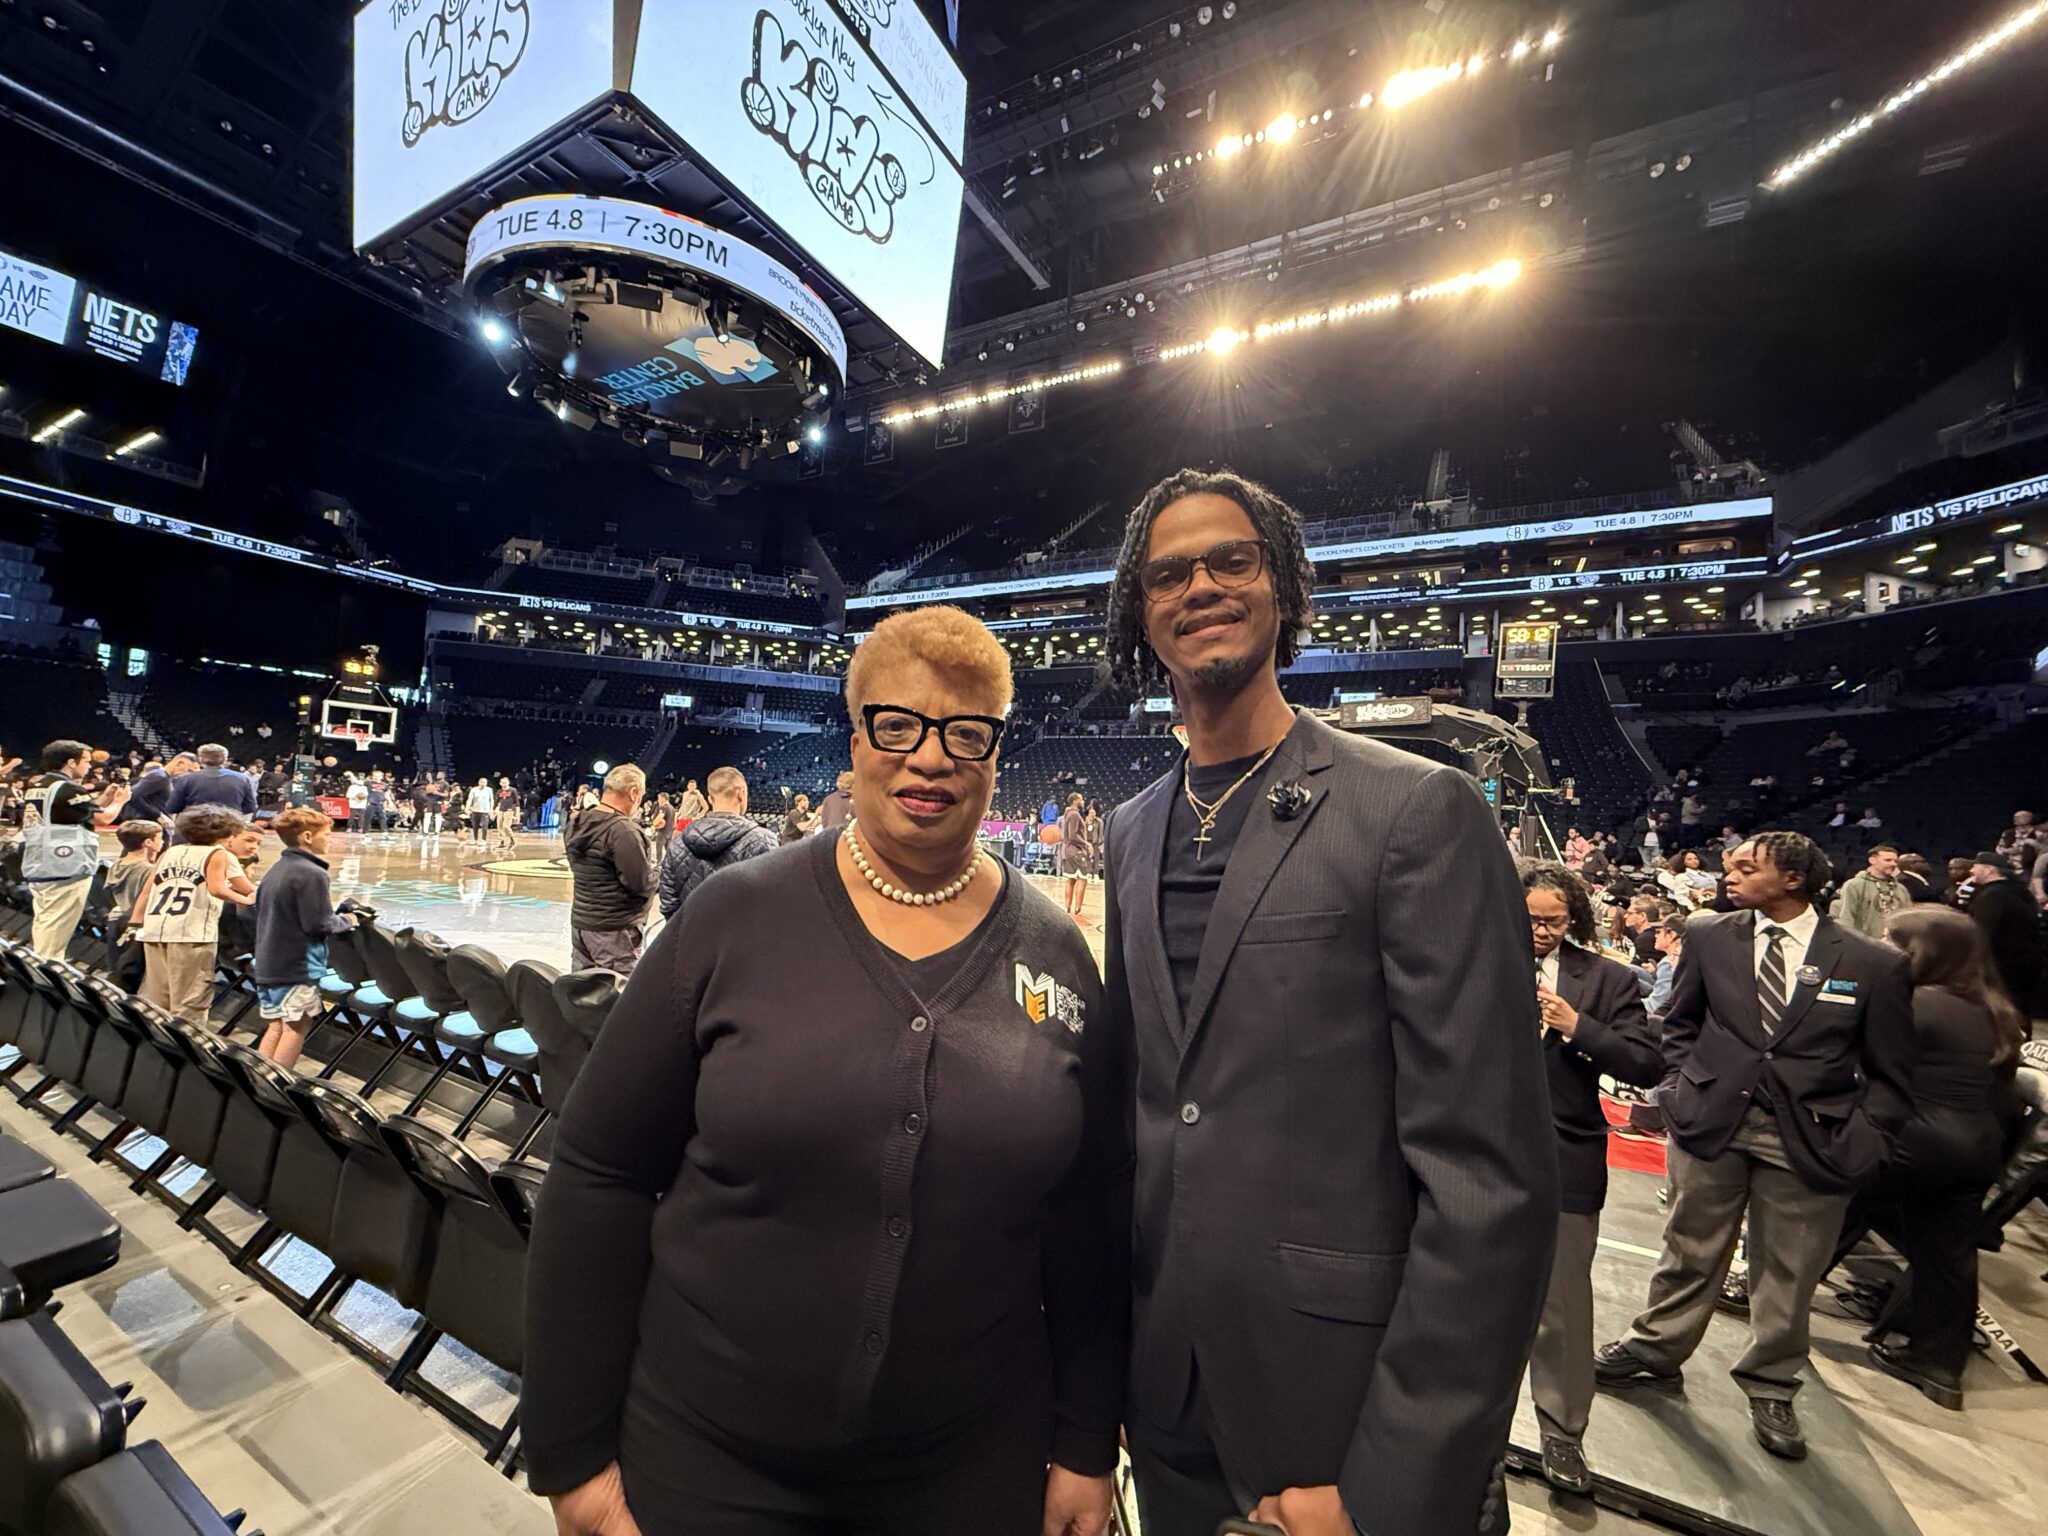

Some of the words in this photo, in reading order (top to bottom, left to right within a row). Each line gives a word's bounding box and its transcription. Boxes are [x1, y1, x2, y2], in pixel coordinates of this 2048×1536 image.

[832, 25, 856, 82] Way
[455, 75, 491, 117] GAME
[815, 174, 854, 226] GAME
[497, 210, 539, 240] TUE
[546, 209, 583, 231] 4.8
[624, 215, 729, 268] 7:30PM
[0, 275, 52, 311] AME
[83, 292, 158, 344] NETS
[789, 300, 837, 351] ticketmaster
[592, 356, 679, 390] CENTER
[607, 370, 706, 407] BARCLAYS
[1594, 518, 1617, 529] TUE
[1619, 516, 1637, 526] 4.8
[1651, 510, 1694, 523] 7:30PM
[1892, 506, 1934, 534] NETS
[1937, 501, 1963, 519] VS
[146, 515, 162, 526] VS
[211, 531, 236, 545] TUE
[236, 537, 254, 550] 4.8
[264, 544, 302, 561] 7:30PM
[1558, 577, 1571, 586] VS
[1620, 571, 1646, 582] TUE
[1646, 569, 1666, 580] 4.8
[1679, 564, 1726, 578] 7:30PM
[519, 596, 541, 609] NETS
[541, 599, 552, 609] VS
[553, 600, 592, 613] PELICANS
[1507, 627, 1550, 644] 58:12
[1515, 663, 1552, 672] TISSOT
[147, 886, 194, 916] 15
